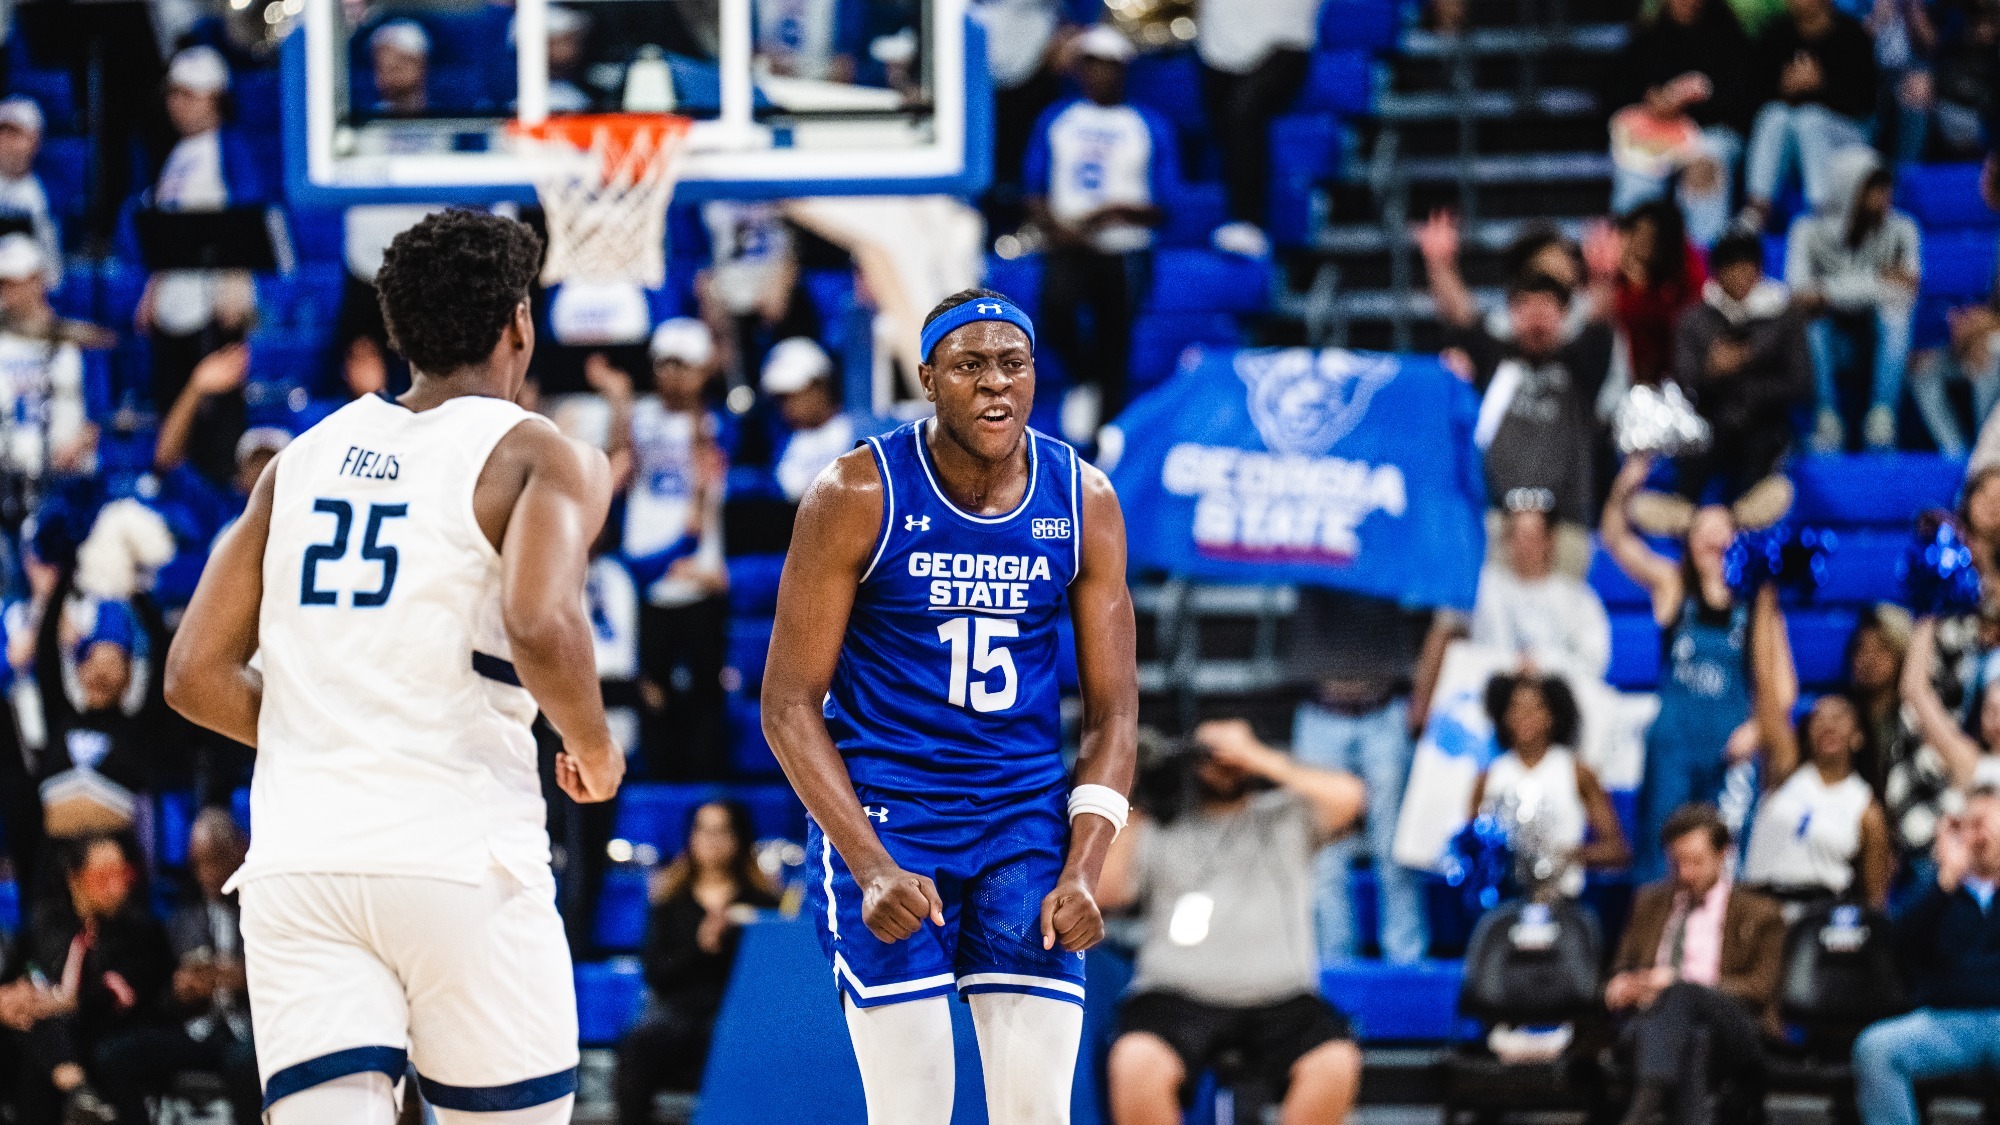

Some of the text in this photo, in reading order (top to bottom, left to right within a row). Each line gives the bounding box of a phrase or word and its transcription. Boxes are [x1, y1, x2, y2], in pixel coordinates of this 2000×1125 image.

[340, 446, 400, 480] FIELDS
[1032, 518, 1071, 539] SBC
[299, 498, 409, 608] 25
[908, 552, 1051, 581] GEORGIA
[929, 580, 1030, 608] STATE
[936, 617, 1020, 713] 15
